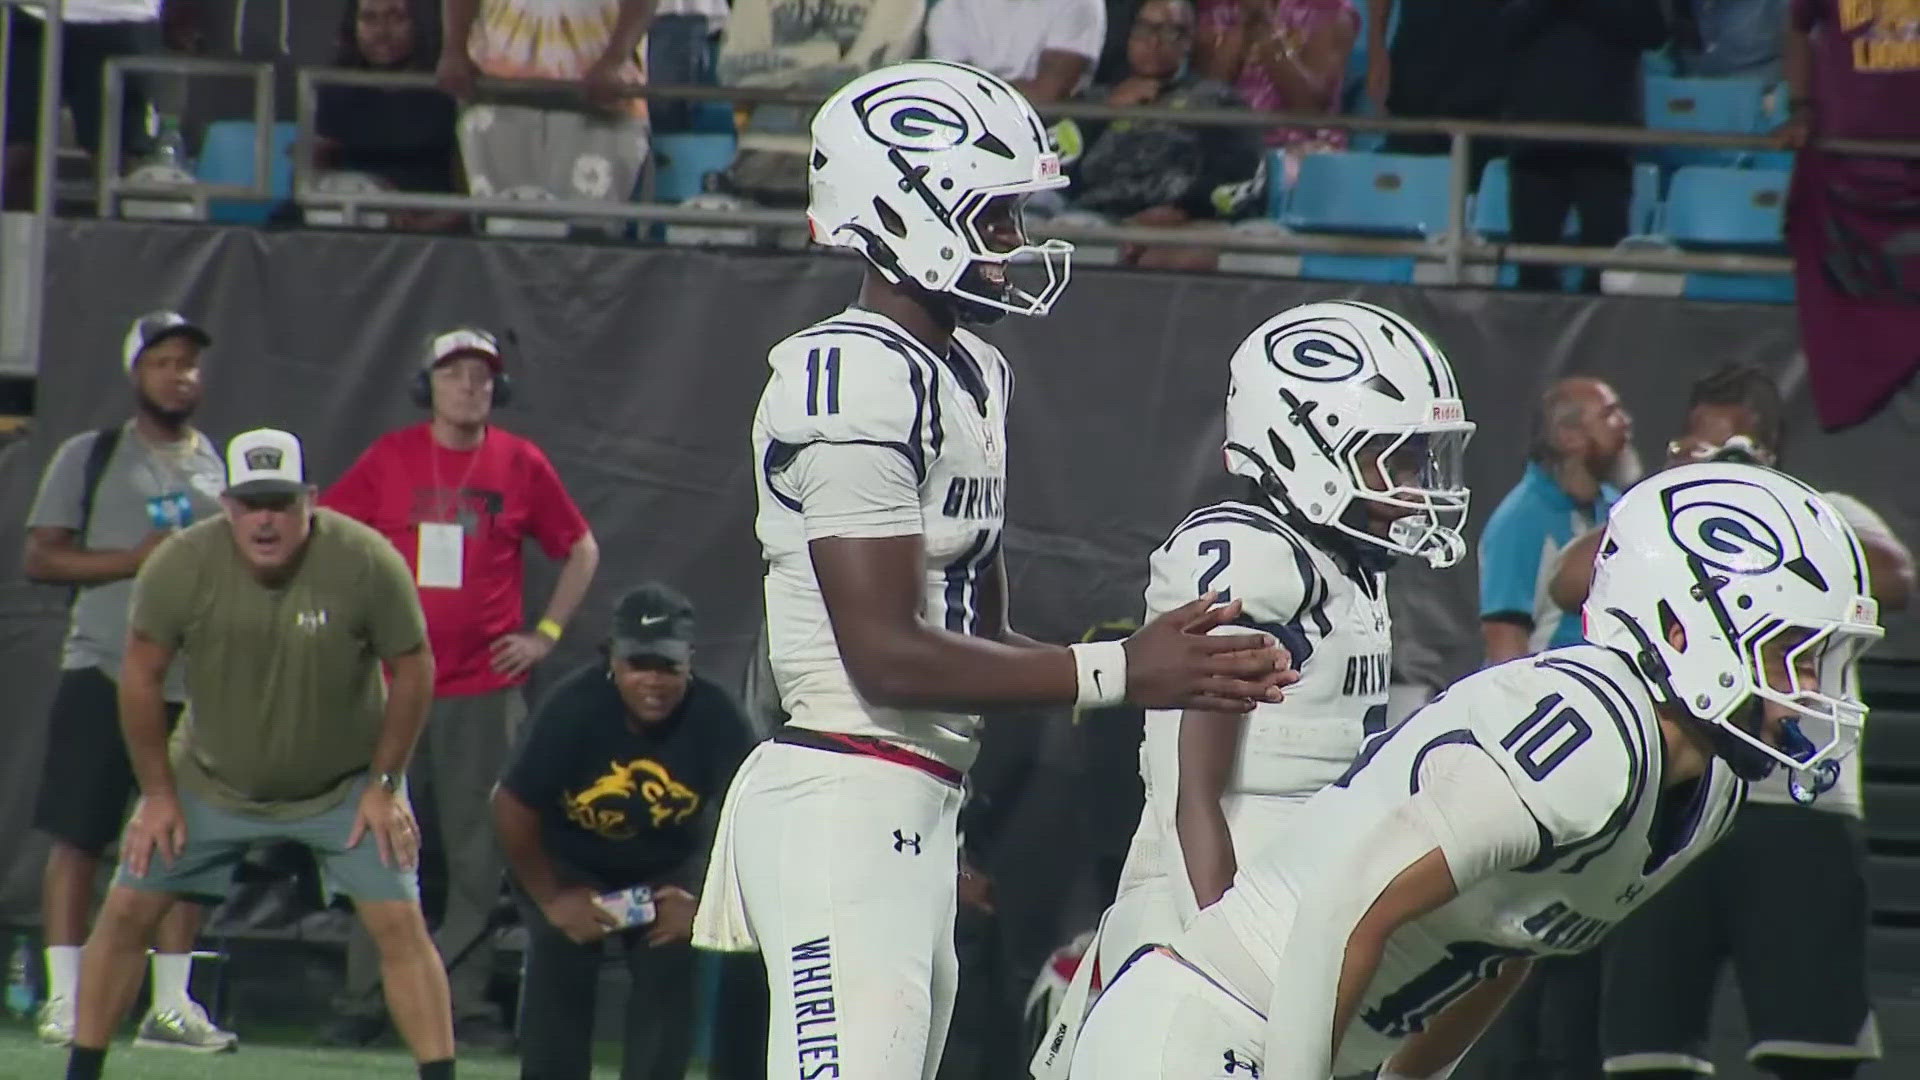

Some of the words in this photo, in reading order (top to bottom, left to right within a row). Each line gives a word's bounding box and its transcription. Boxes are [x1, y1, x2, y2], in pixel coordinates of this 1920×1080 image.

[806, 347, 841, 416] 11
[1198, 540, 1231, 604] 2
[1500, 692, 1593, 782] 10
[791, 934, 840, 1080] WHIRLIES
